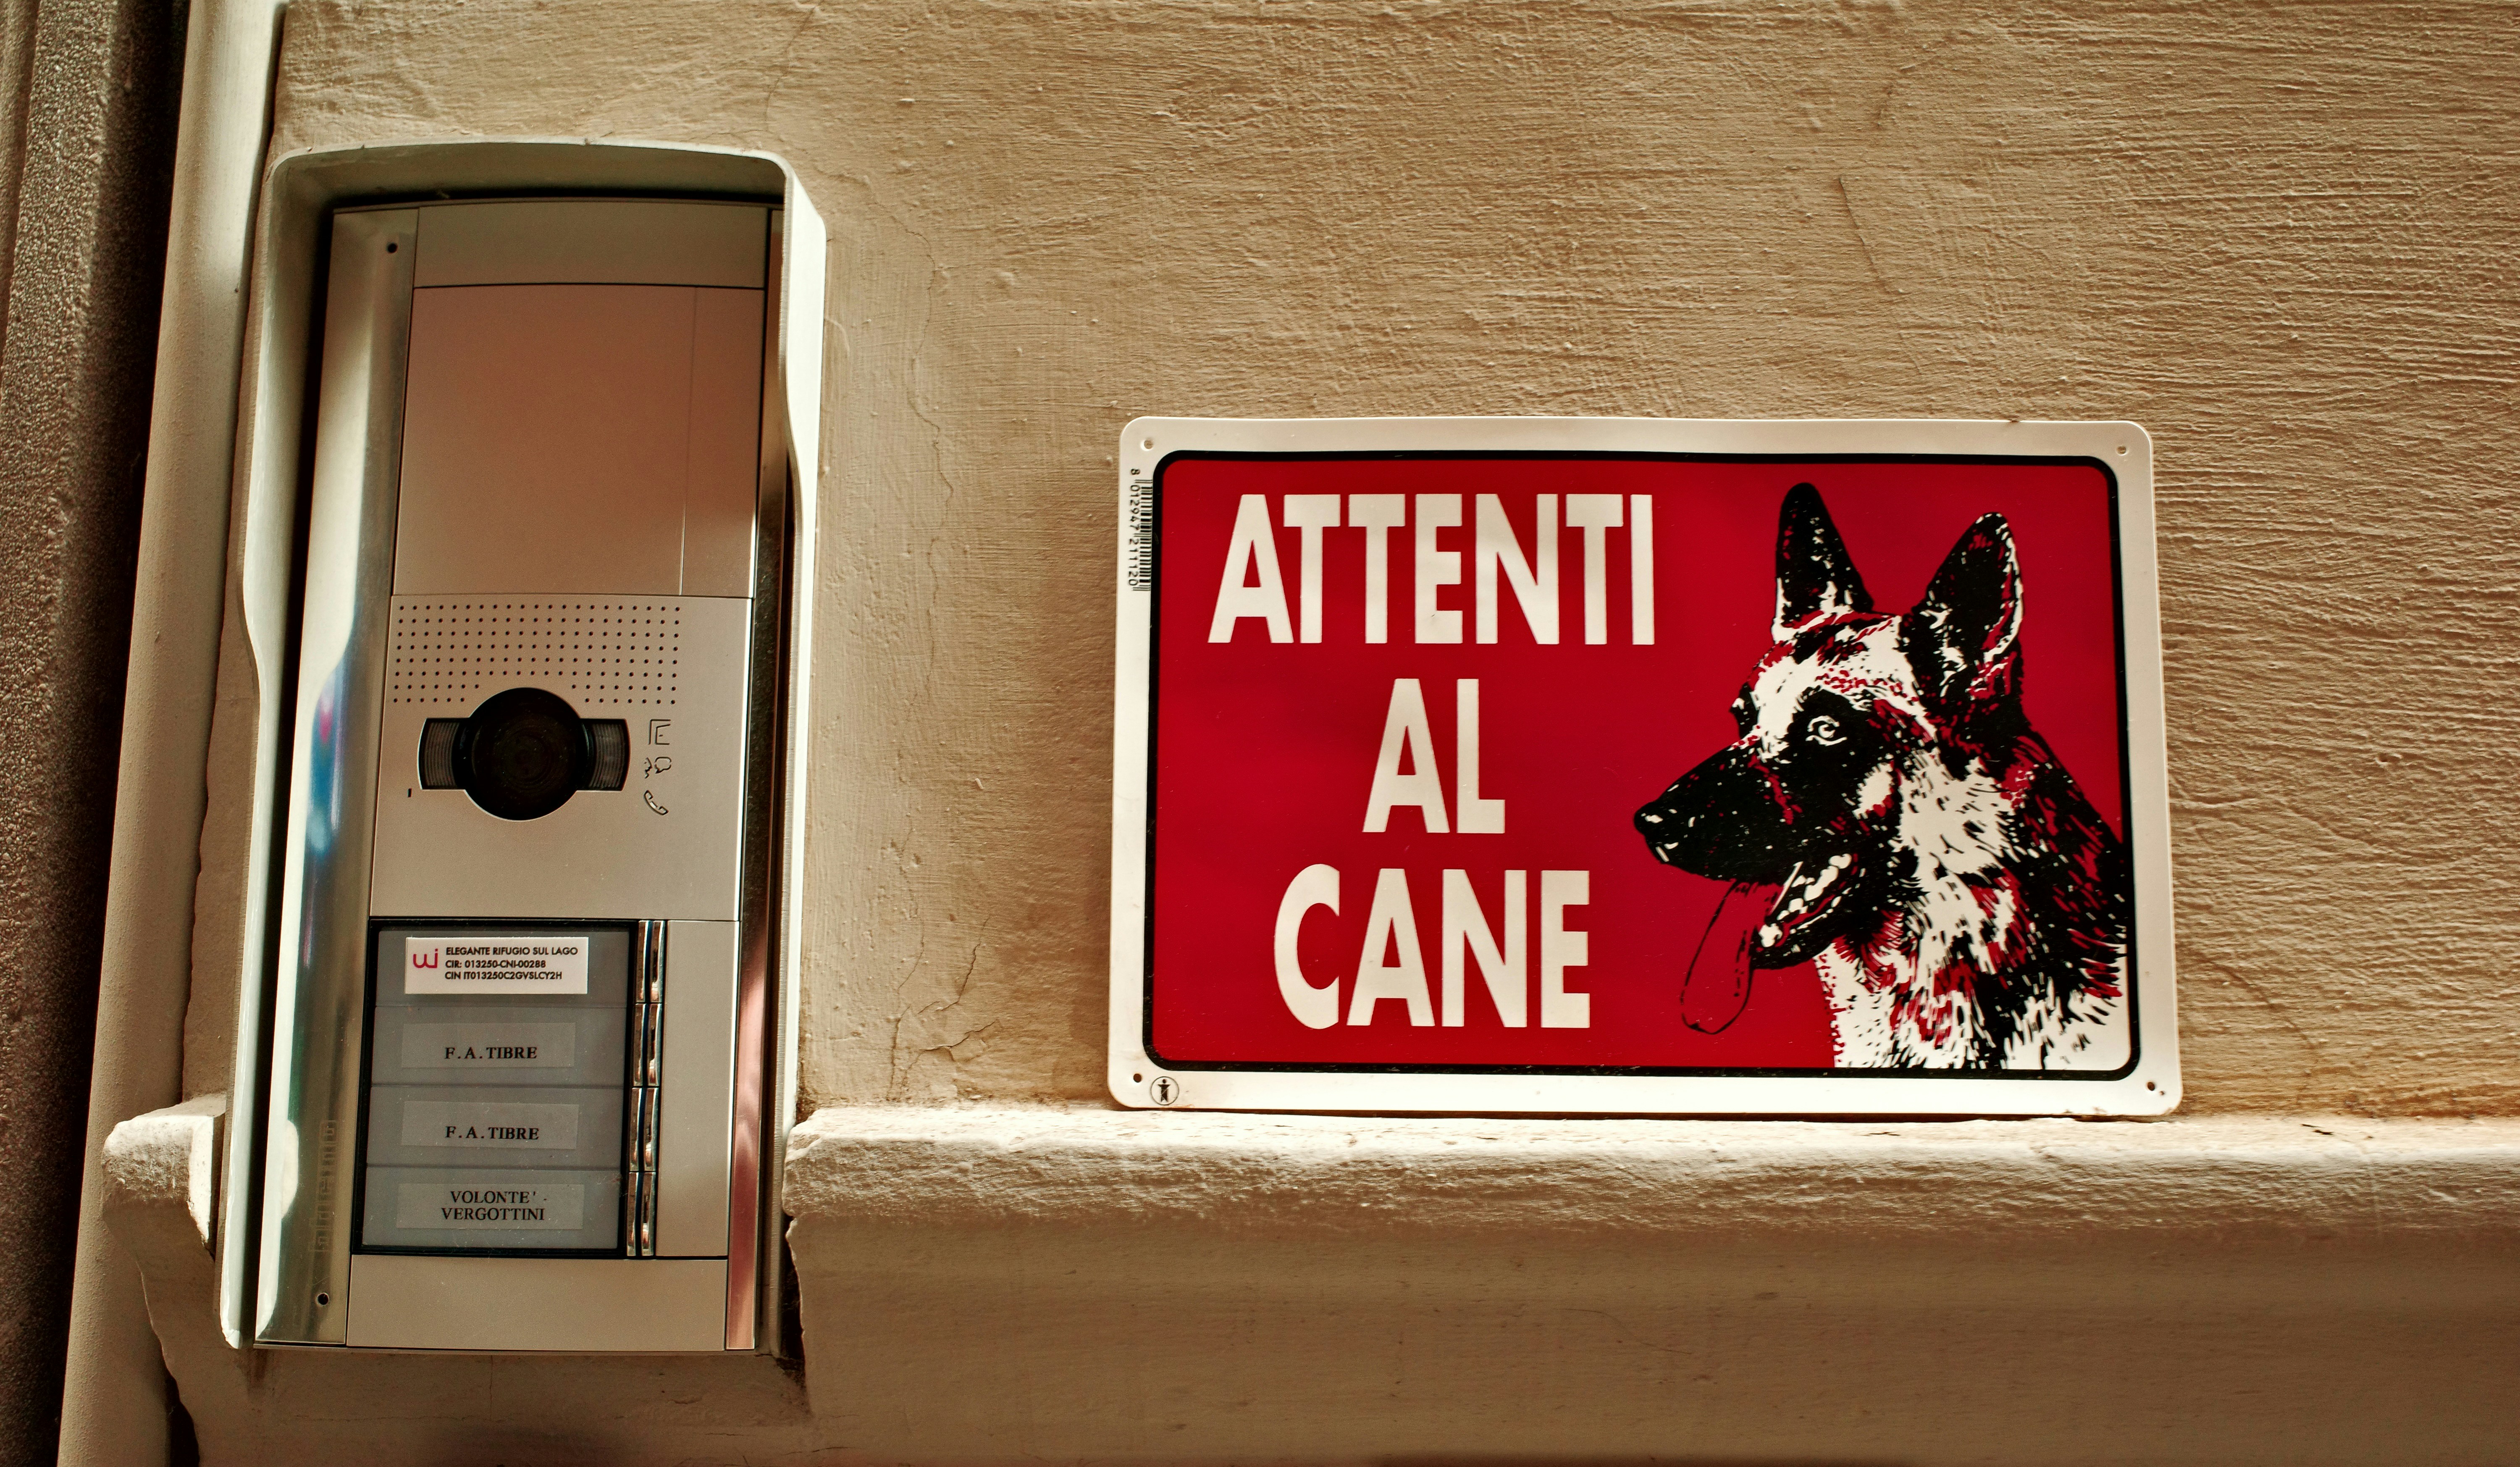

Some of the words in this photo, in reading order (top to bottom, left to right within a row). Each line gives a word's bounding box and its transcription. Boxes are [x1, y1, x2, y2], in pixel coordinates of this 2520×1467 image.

[1129, 484, 1141, 531] 012947
[1128, 538, 1140, 586] 211120
[1207, 494, 1655, 645] ATTENTI
[1362, 678, 1506, 834] AL
[445, 946, 491, 956] ELEGANTE
[492, 946, 531, 956] RIFUGIO
[532, 946, 549, 956] SUL
[551, 946, 578, 956] LAGO
[445, 960, 462, 968] CIR:
[464, 960, 546, 968] 013250-CNI-00288
[1273, 863, 1590, 1030] CANE
[444, 971, 462, 980] CIN
[441, 1207, 546, 1221] VERGOTTINI
